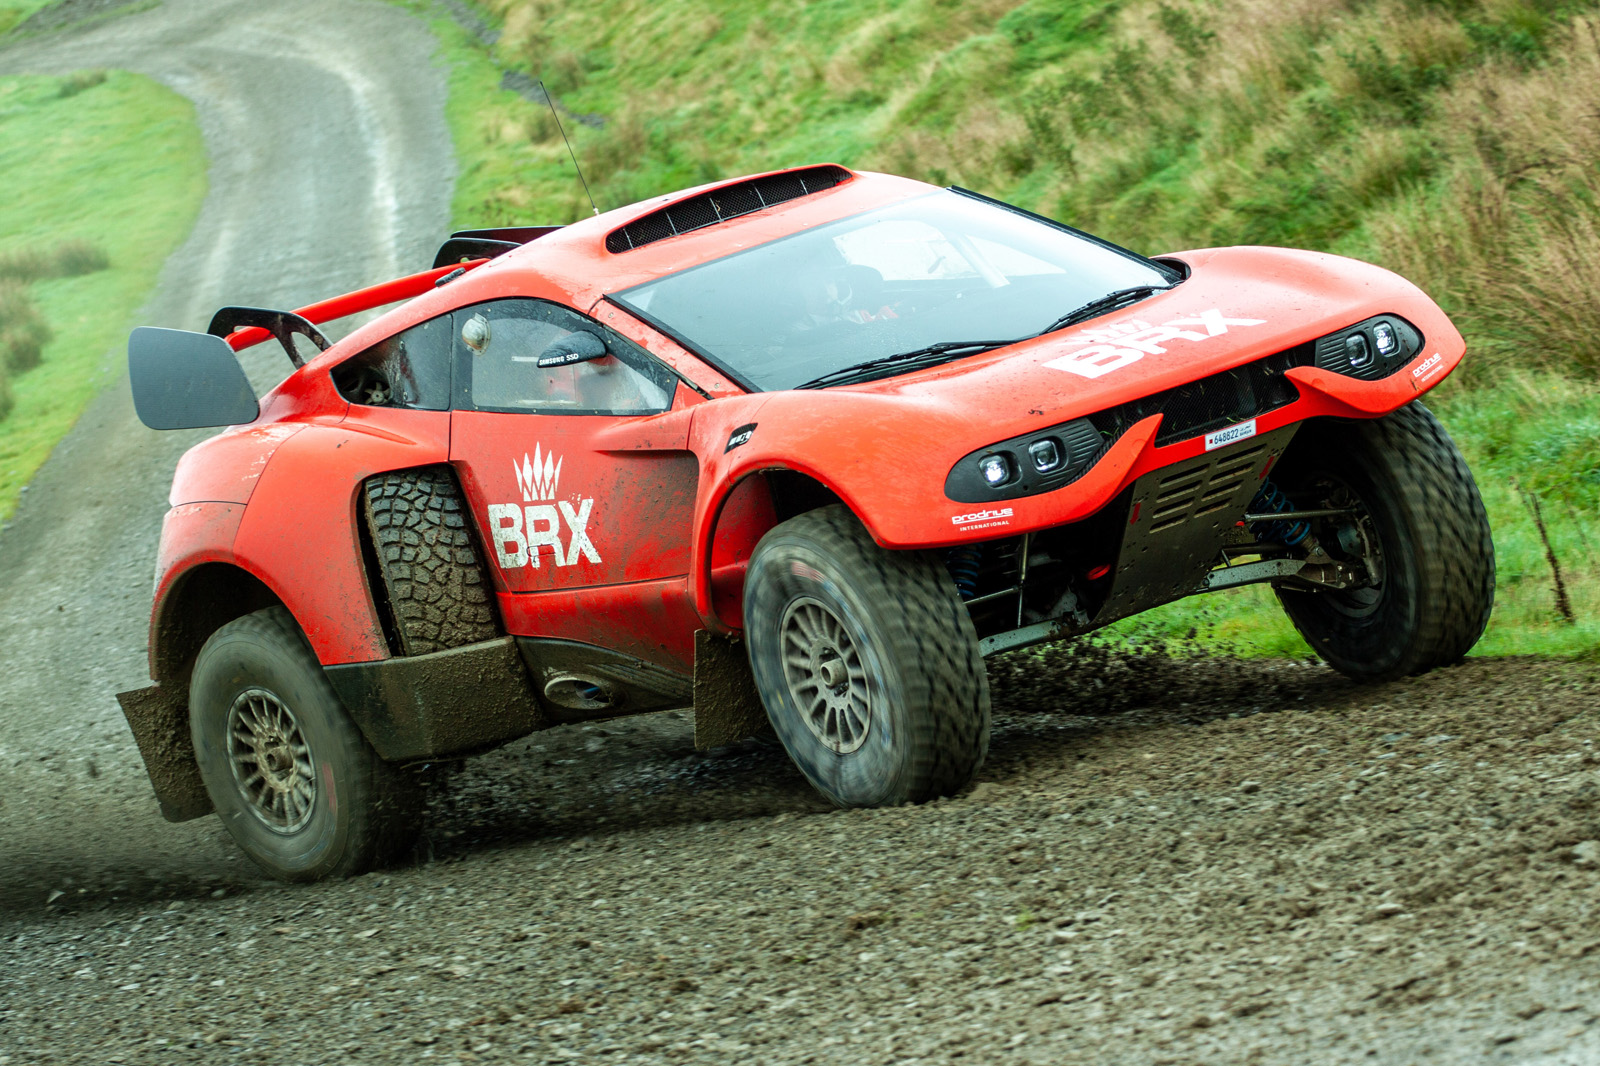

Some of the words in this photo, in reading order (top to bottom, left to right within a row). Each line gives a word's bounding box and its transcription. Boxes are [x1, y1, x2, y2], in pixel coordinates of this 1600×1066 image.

[1041, 308, 1268, 379] BRX
[539, 356, 565, 366] SAMSUNG
[566, 353, 579, 361] SSD
[1214, 428, 1239, 445] 648822
[951, 508, 1014, 525] prodrive
[487, 498, 602, 569] BRX
[959, 520, 1010, 531] INTERNATIONAL
